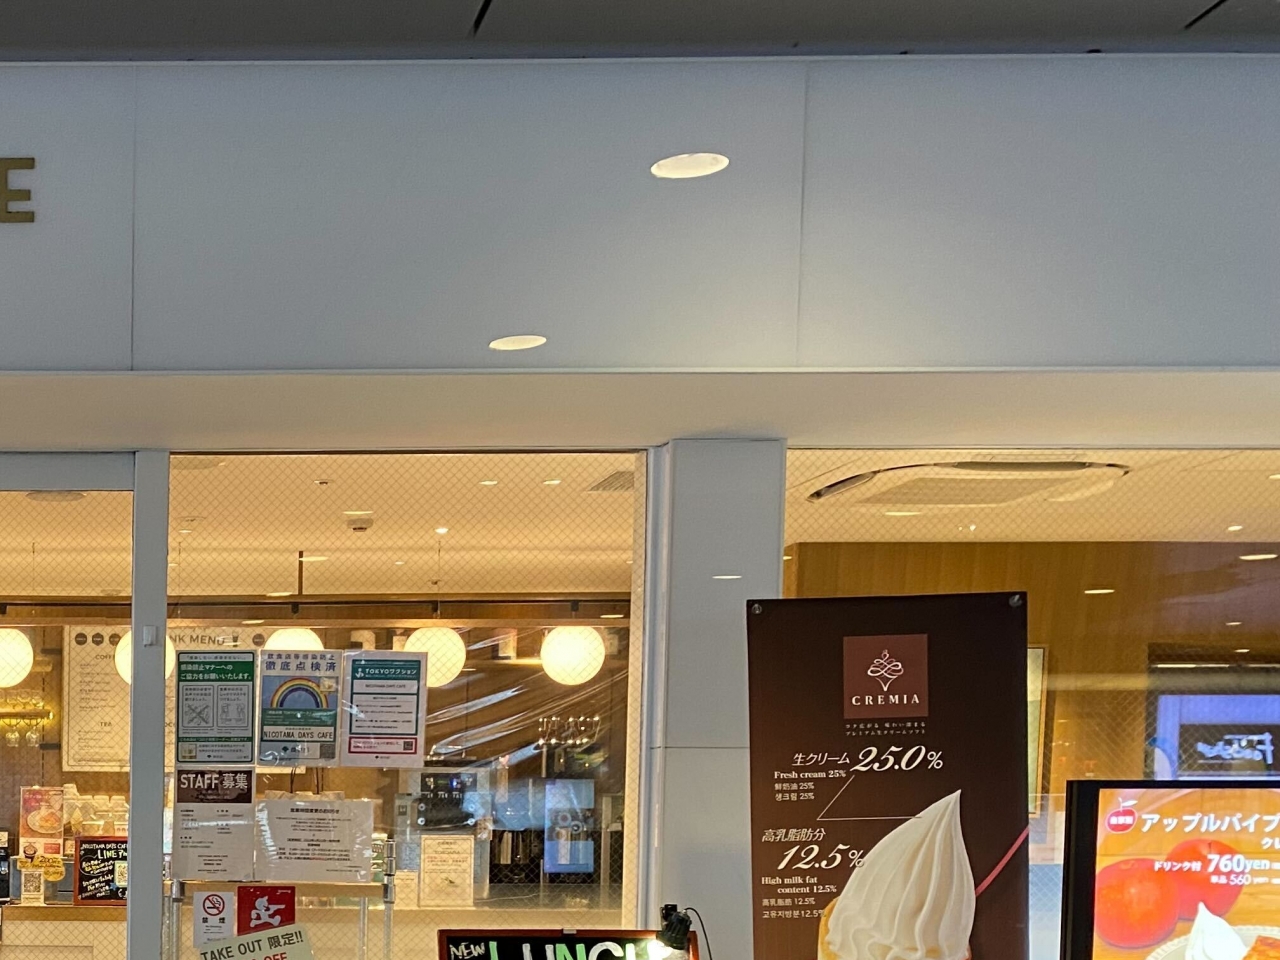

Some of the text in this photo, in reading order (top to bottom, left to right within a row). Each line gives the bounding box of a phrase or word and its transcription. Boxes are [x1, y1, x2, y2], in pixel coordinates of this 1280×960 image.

[265, 661, 336, 672] 徹底点検済
[851, 694, 920, 706] CREMIA
[264, 730, 333, 739] NICOTAMA DAYS CAFE
[792, 745, 944, 772] 生クリーム 25.0%
[774, 769, 846, 779] Fresh cream 25%
[180, 772, 248, 789] STAFF 募集
[798, 782, 815, 790] 25%
[799, 792, 815, 800] 25%
[761, 828, 826, 842] 高乳脂肪分
[777, 843, 865, 870] 12.5%
[1154, 861, 1202, 872] ドリンク付
[761, 875, 818, 885] High milk fat
[813, 885, 837, 893] 12.5%
[794, 897, 816, 905] 12.5%
[237, 939, 263, 955] OUT
[267, 930, 304, 950] 限定!!
[449, 942, 485, 960] NEW
